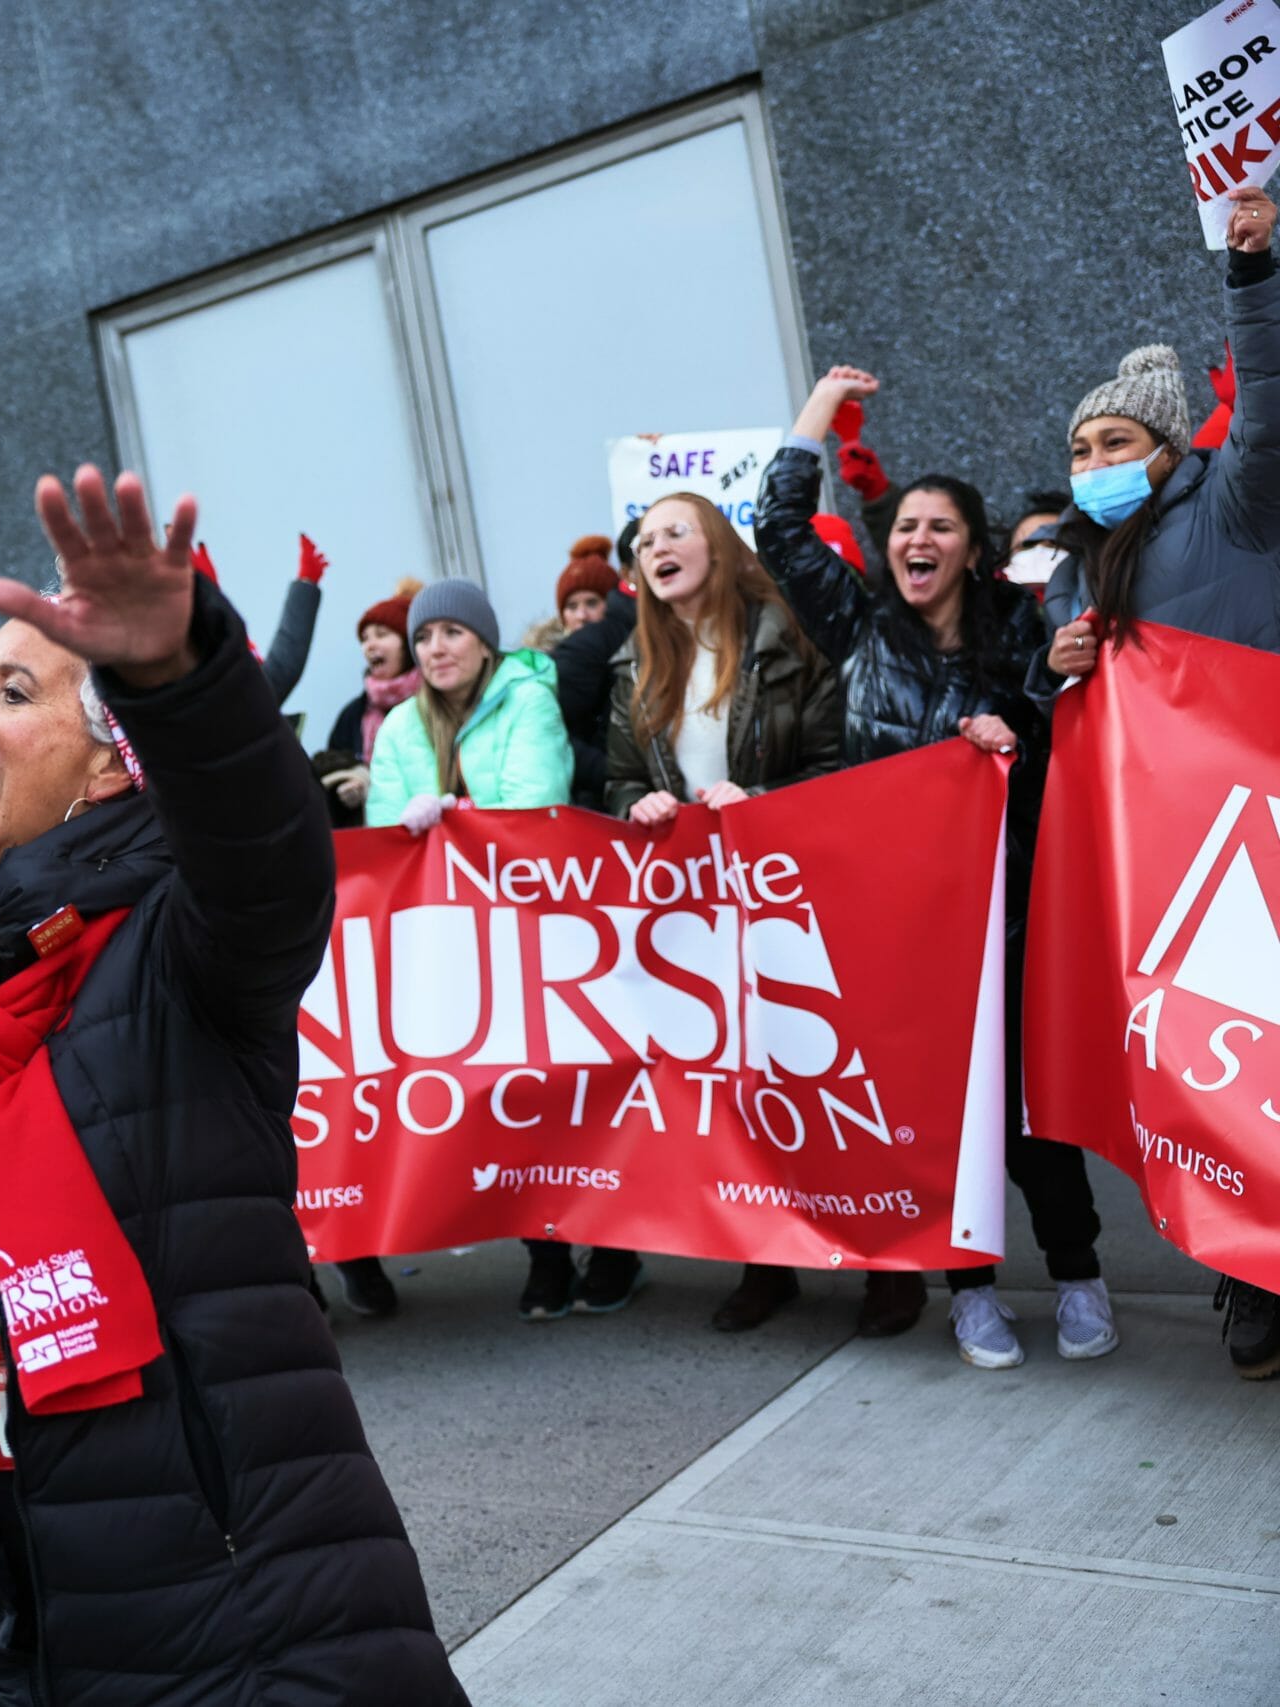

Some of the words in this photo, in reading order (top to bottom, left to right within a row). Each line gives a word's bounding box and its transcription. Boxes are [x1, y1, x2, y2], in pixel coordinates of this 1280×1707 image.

[649, 451, 715, 478] SAFE
[444, 840, 602, 904] New
[499, 1161, 621, 1195] nynurses
[17, 1259, 51, 1283] York
[49, 1248, 85, 1271] State
[3, 1258, 94, 1326] RSES
